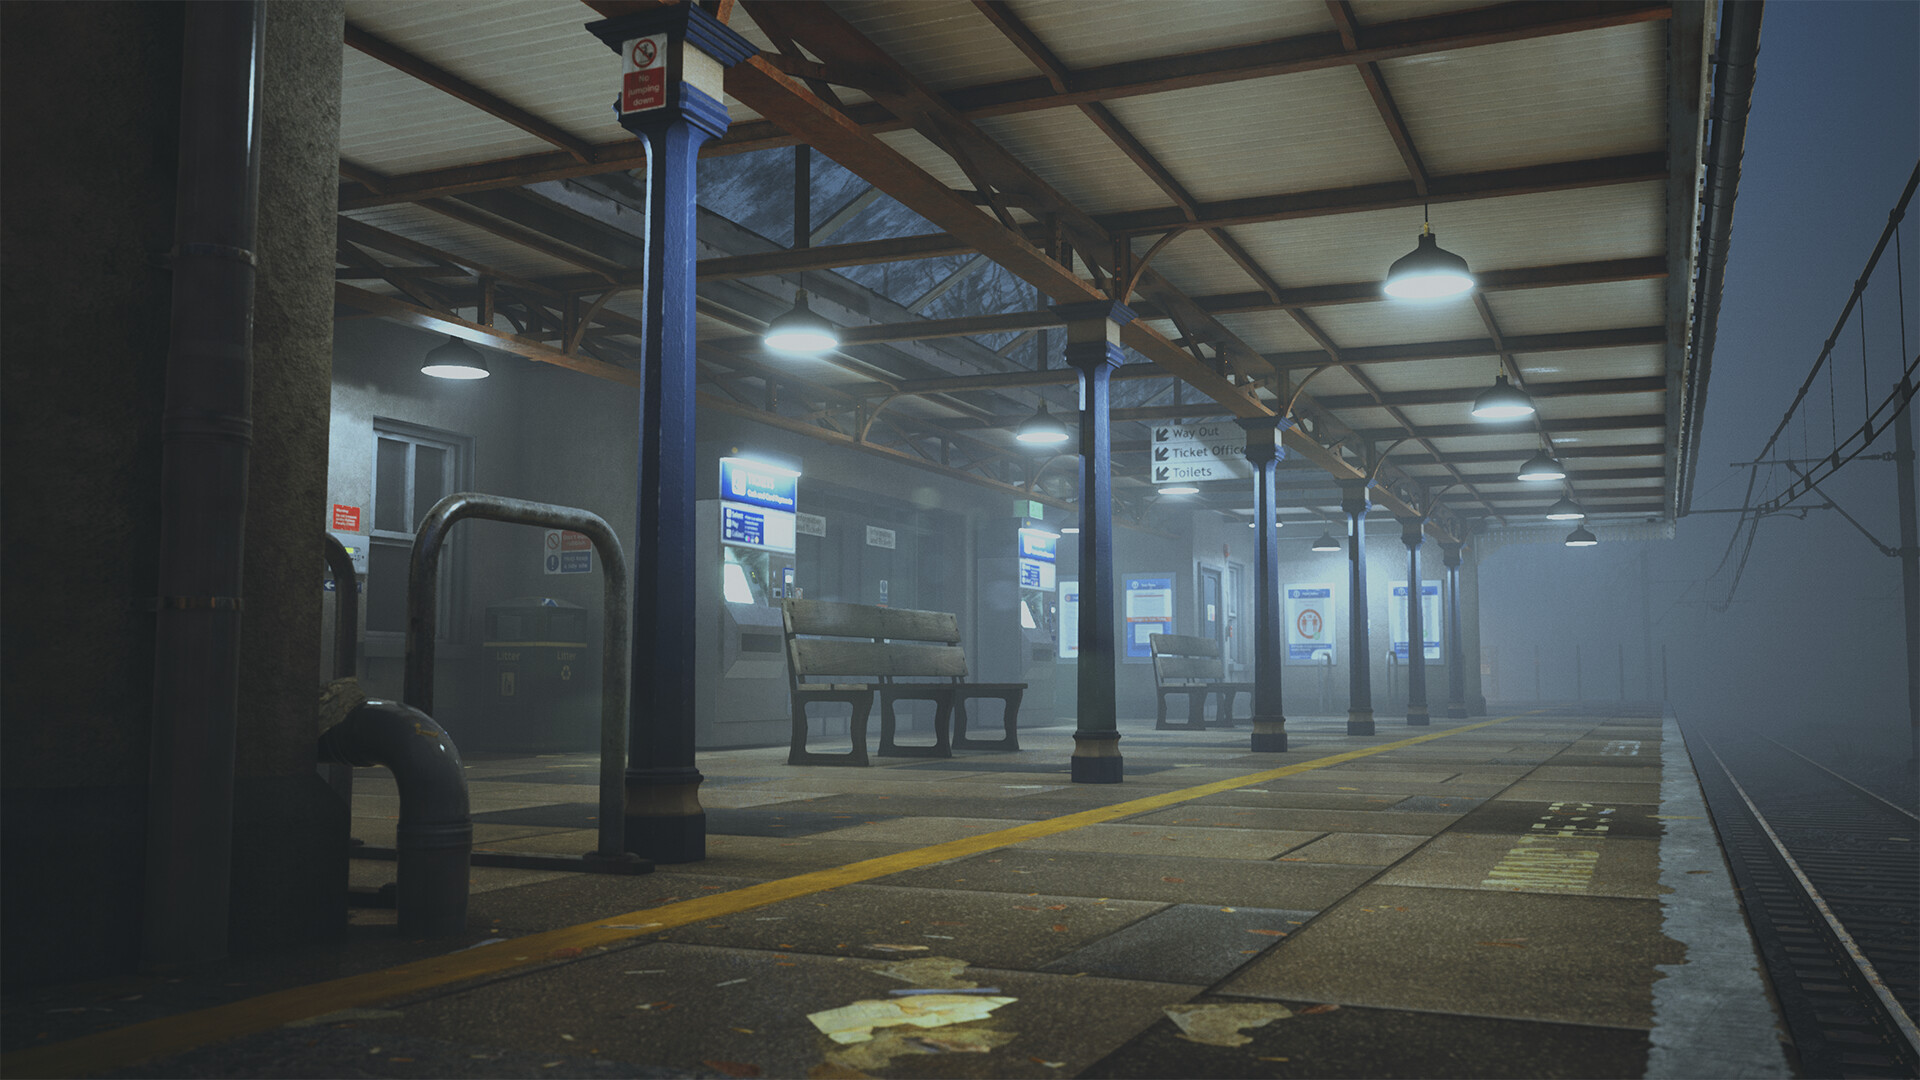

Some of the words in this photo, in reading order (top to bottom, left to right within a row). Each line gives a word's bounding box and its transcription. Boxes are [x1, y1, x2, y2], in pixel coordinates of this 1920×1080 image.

[628, 85, 660, 98] jumping
[633, 97, 654, 106] down
[1172, 429, 1196, 438] Way
[1199, 427, 1220, 437] Out
[1172, 447, 1209, 458] Ticket
[1173, 467, 1212, 478] Toilets
[497, 651, 520, 661] Litter
[557, 650, 577, 661] Litter
